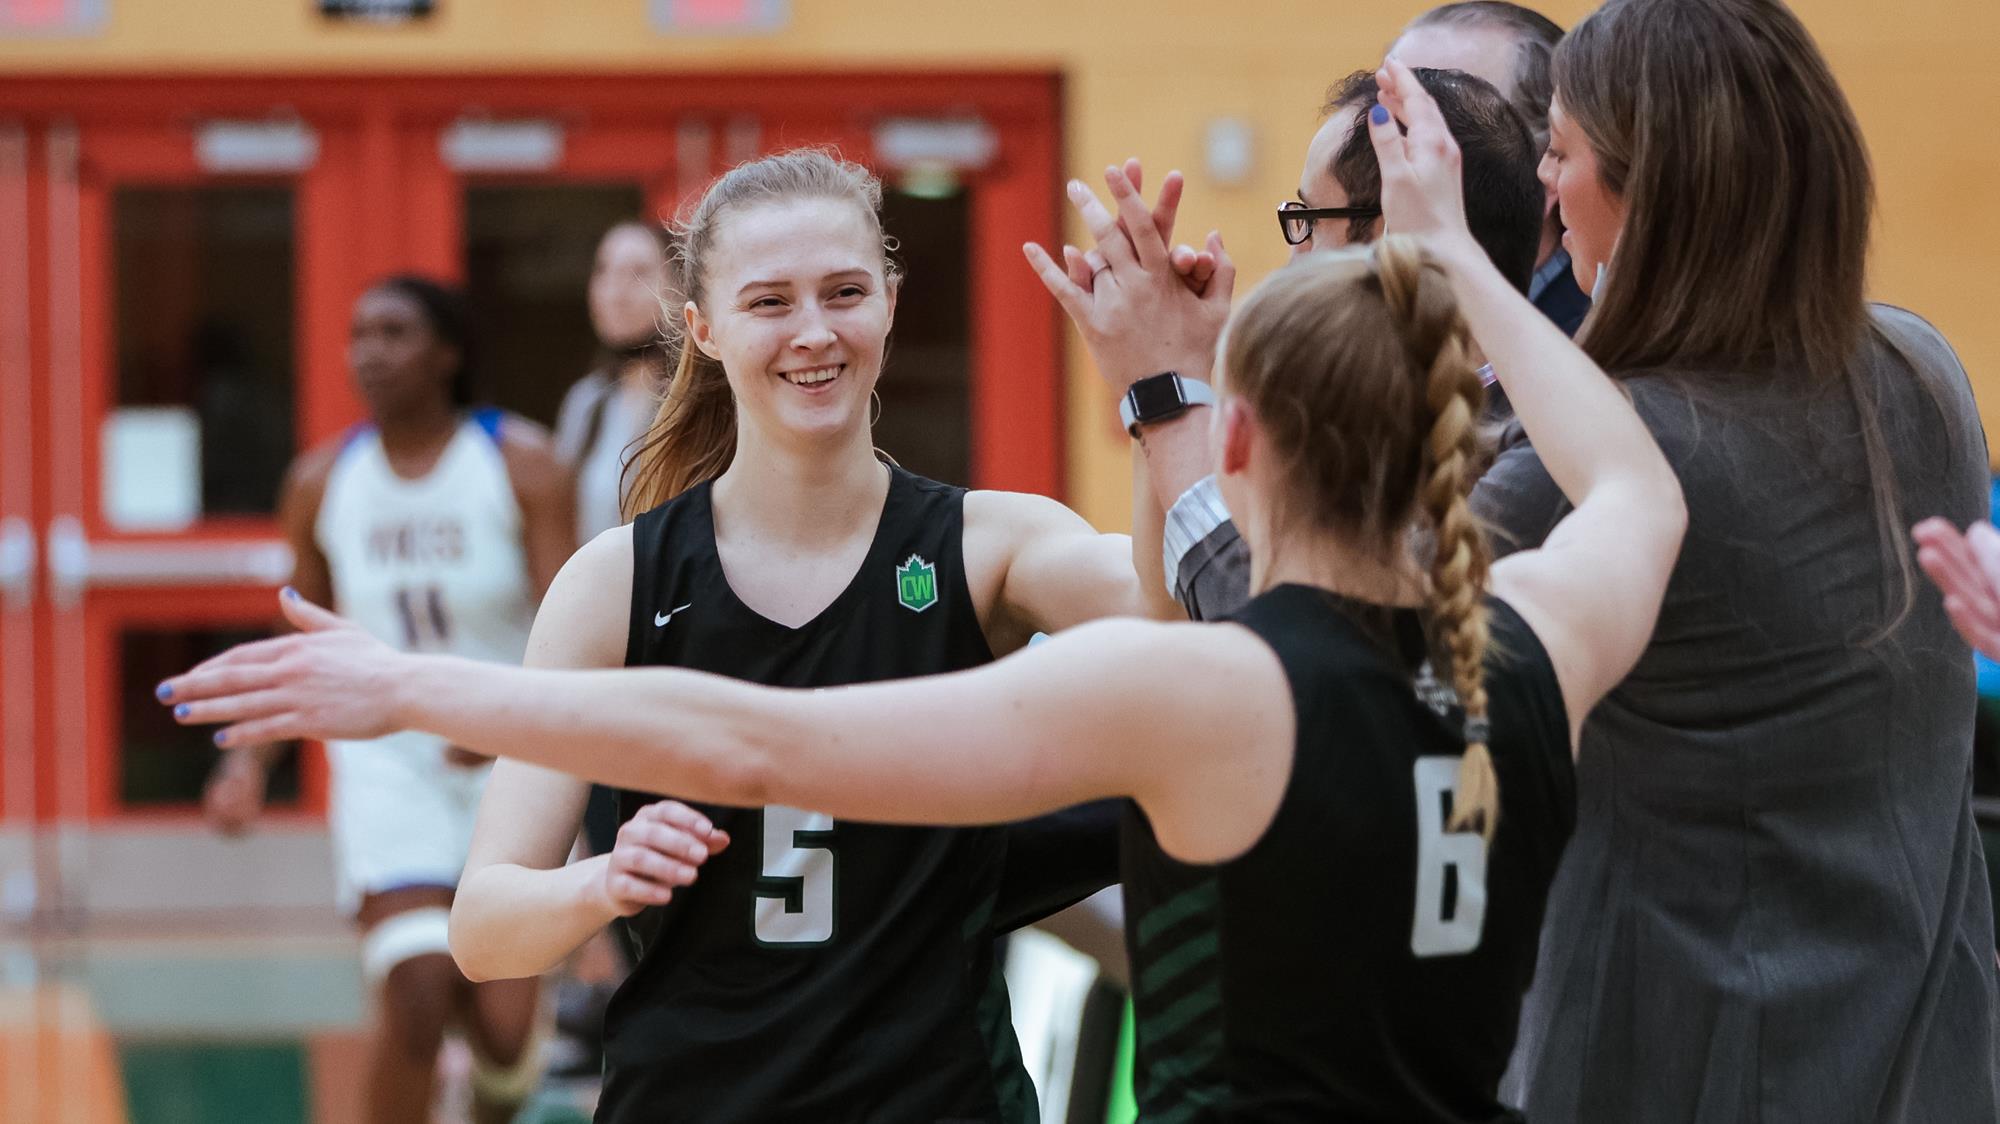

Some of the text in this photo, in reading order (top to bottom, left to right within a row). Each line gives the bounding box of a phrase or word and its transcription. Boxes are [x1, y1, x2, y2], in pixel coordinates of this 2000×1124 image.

[901, 575, 932, 601] CW
[755, 804, 834, 943] 5
[1411, 755, 1488, 958] 6
